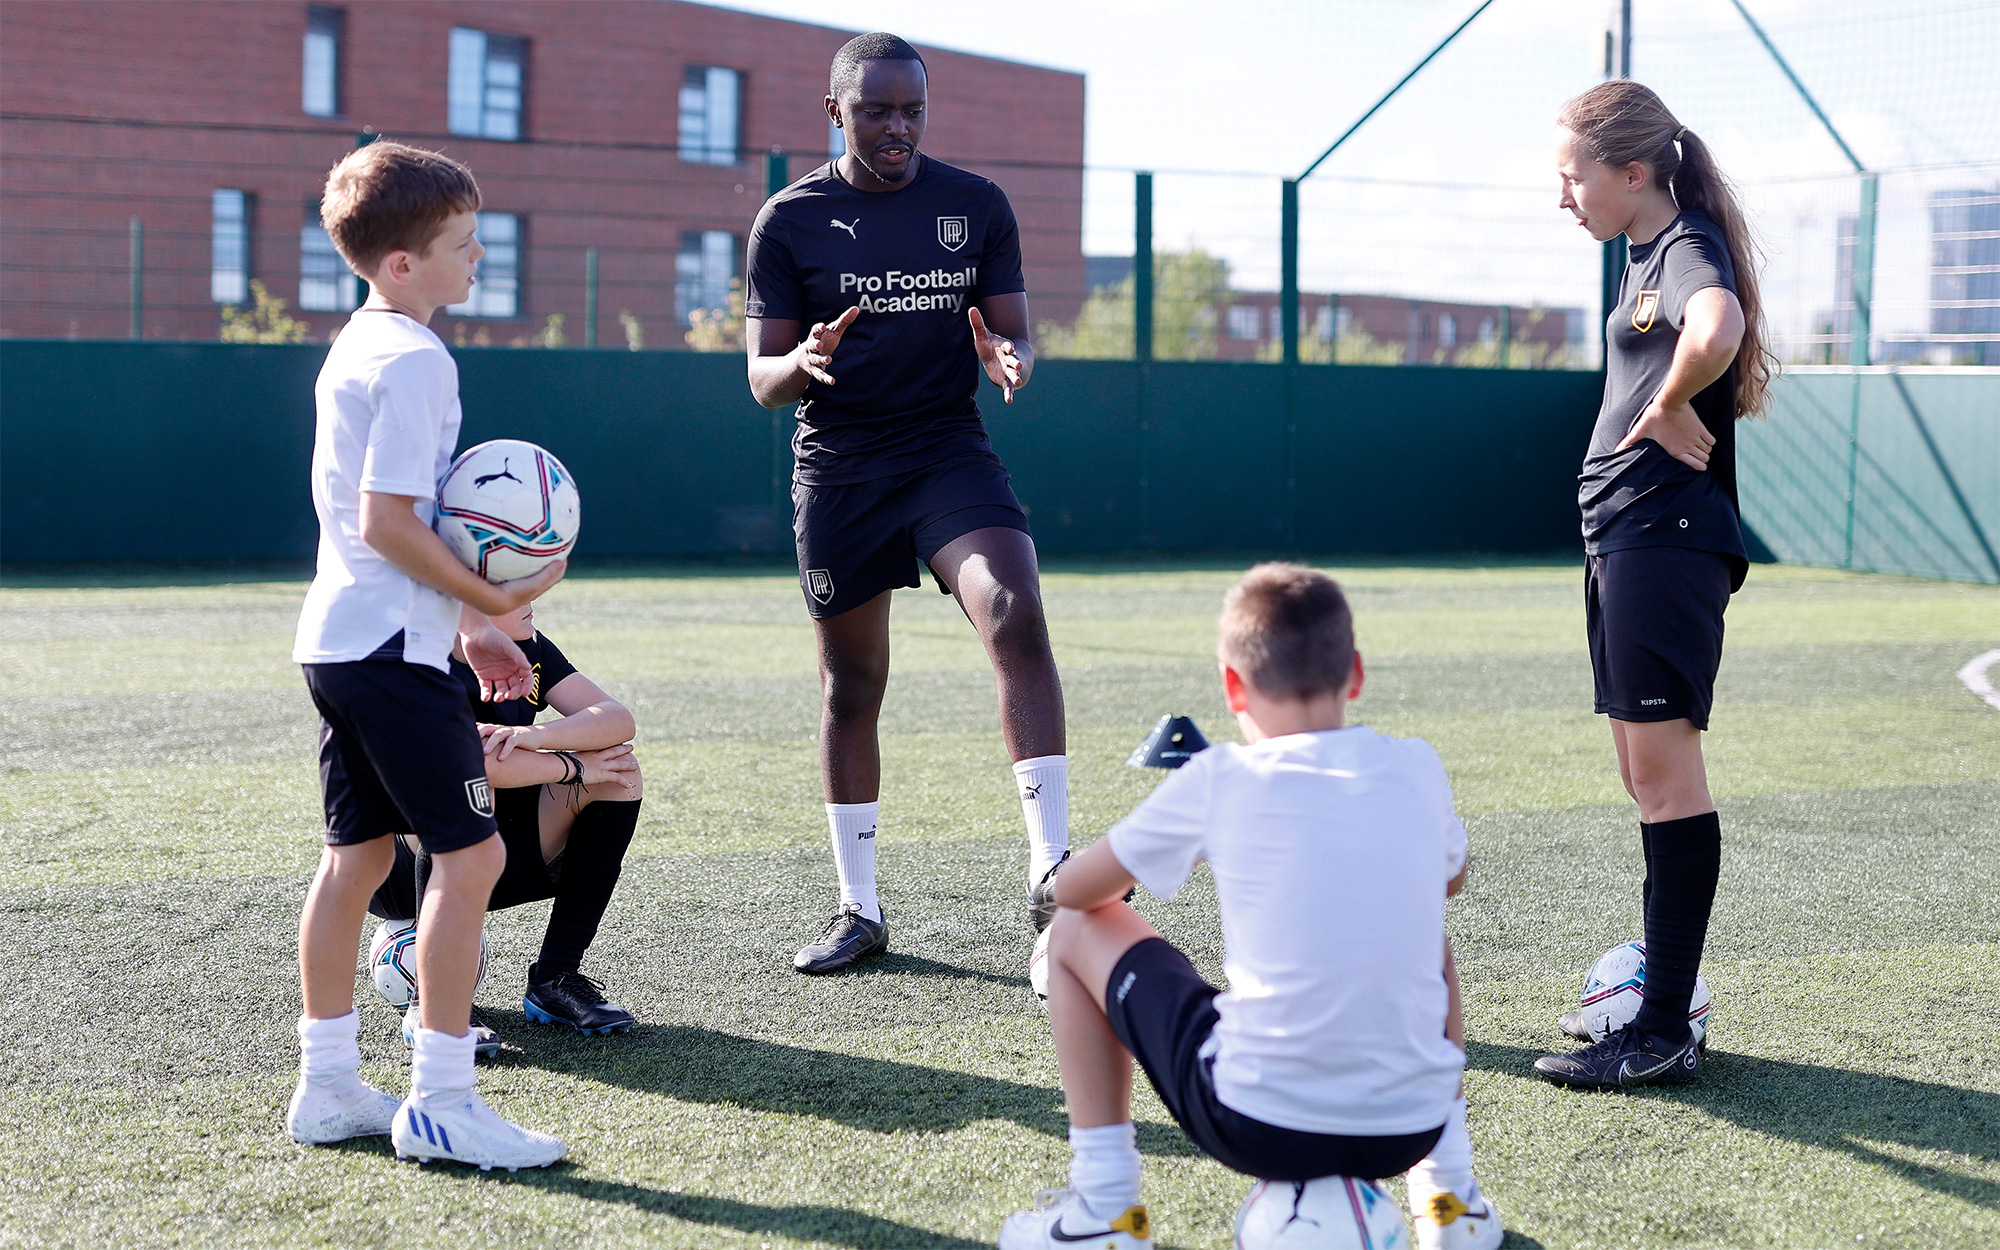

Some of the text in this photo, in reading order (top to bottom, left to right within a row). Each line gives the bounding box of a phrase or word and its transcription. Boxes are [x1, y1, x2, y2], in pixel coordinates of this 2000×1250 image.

[840, 267, 977, 293] Pro Football
[857, 292, 964, 314] Academy
[1640, 698, 1667, 706] KIPSTA
